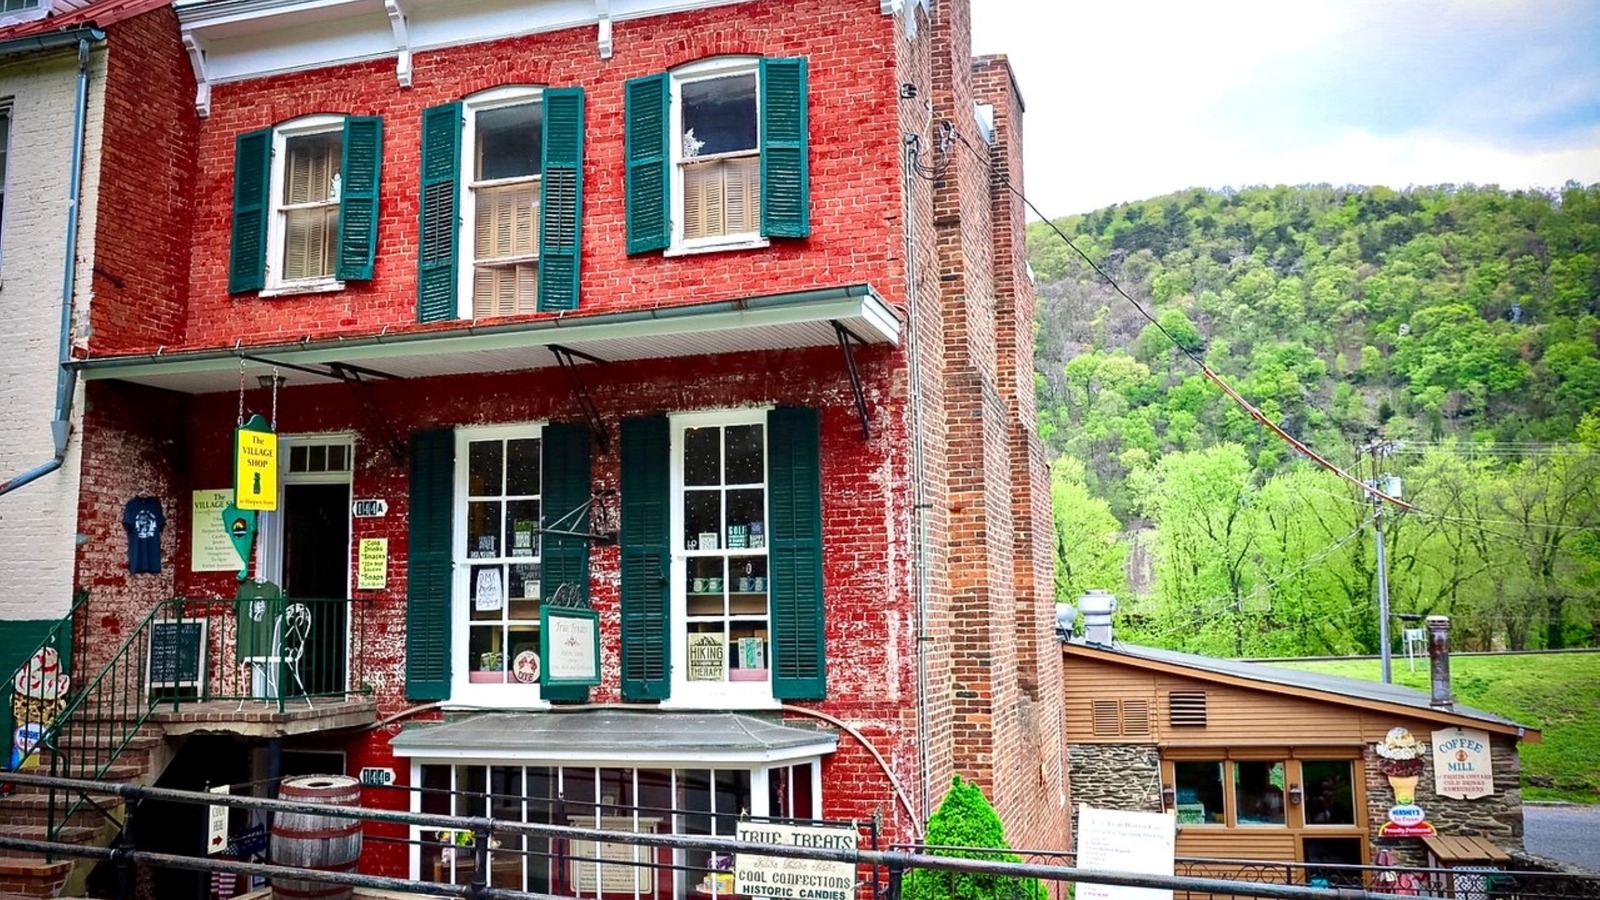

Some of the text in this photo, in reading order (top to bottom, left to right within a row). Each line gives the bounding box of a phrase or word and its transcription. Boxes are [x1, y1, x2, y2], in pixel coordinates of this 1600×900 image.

[252, 435, 265, 445] The
[242, 446, 274, 458] VILLAGE
[247, 459, 269, 468] SHOP
[194, 501, 224, 509] VILLAGE
[690, 647, 723, 659] HIKING
[691, 668, 722, 676] THERAPY
[1439, 738, 1483, 753] COFFEE
[1447, 762, 1475, 771] MILL
[791, 832, 853, 850] TREATS
[739, 869, 851, 890] COOL CONFECTIONS
[743, 885, 846, 900] HISTORIC CANDIES
